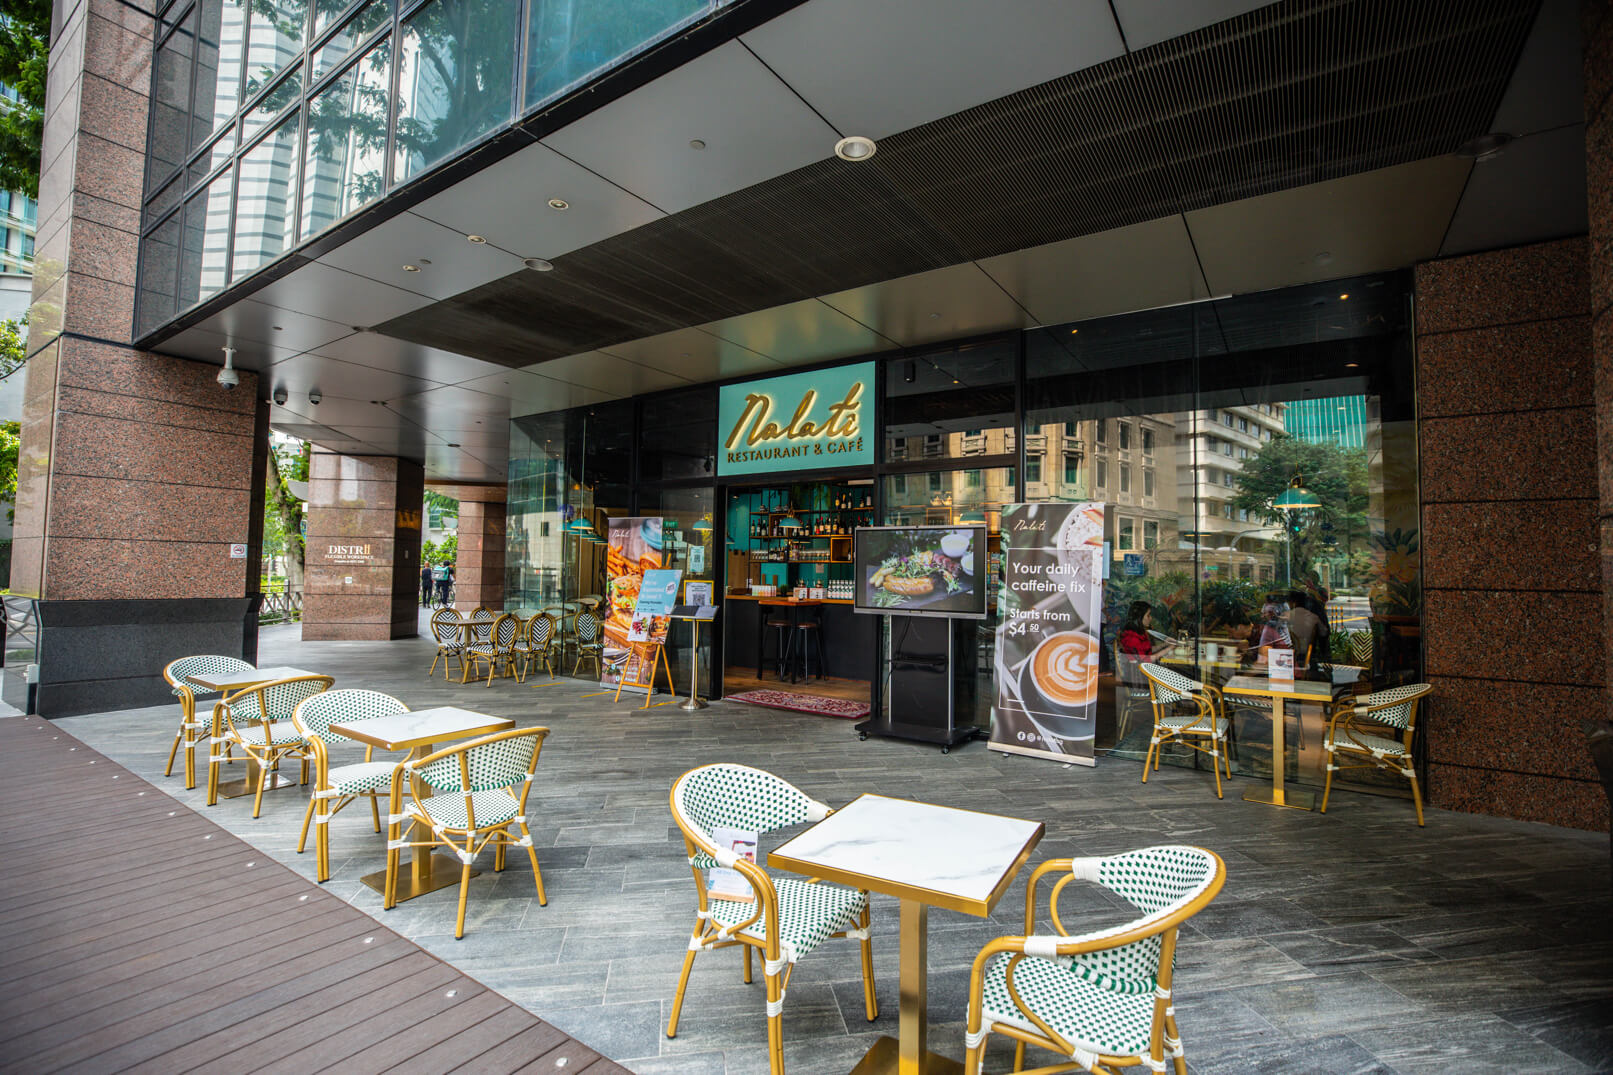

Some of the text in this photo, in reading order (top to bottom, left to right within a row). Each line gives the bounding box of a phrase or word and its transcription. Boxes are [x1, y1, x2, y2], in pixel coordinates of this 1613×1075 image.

[727, 437, 863, 463] RESTAURANT & CAFÉ
[1012, 562, 1080, 577] Your daily
[1011, 580, 1086, 593] caffeine fix
[1009, 608, 1071, 621] Starts from
